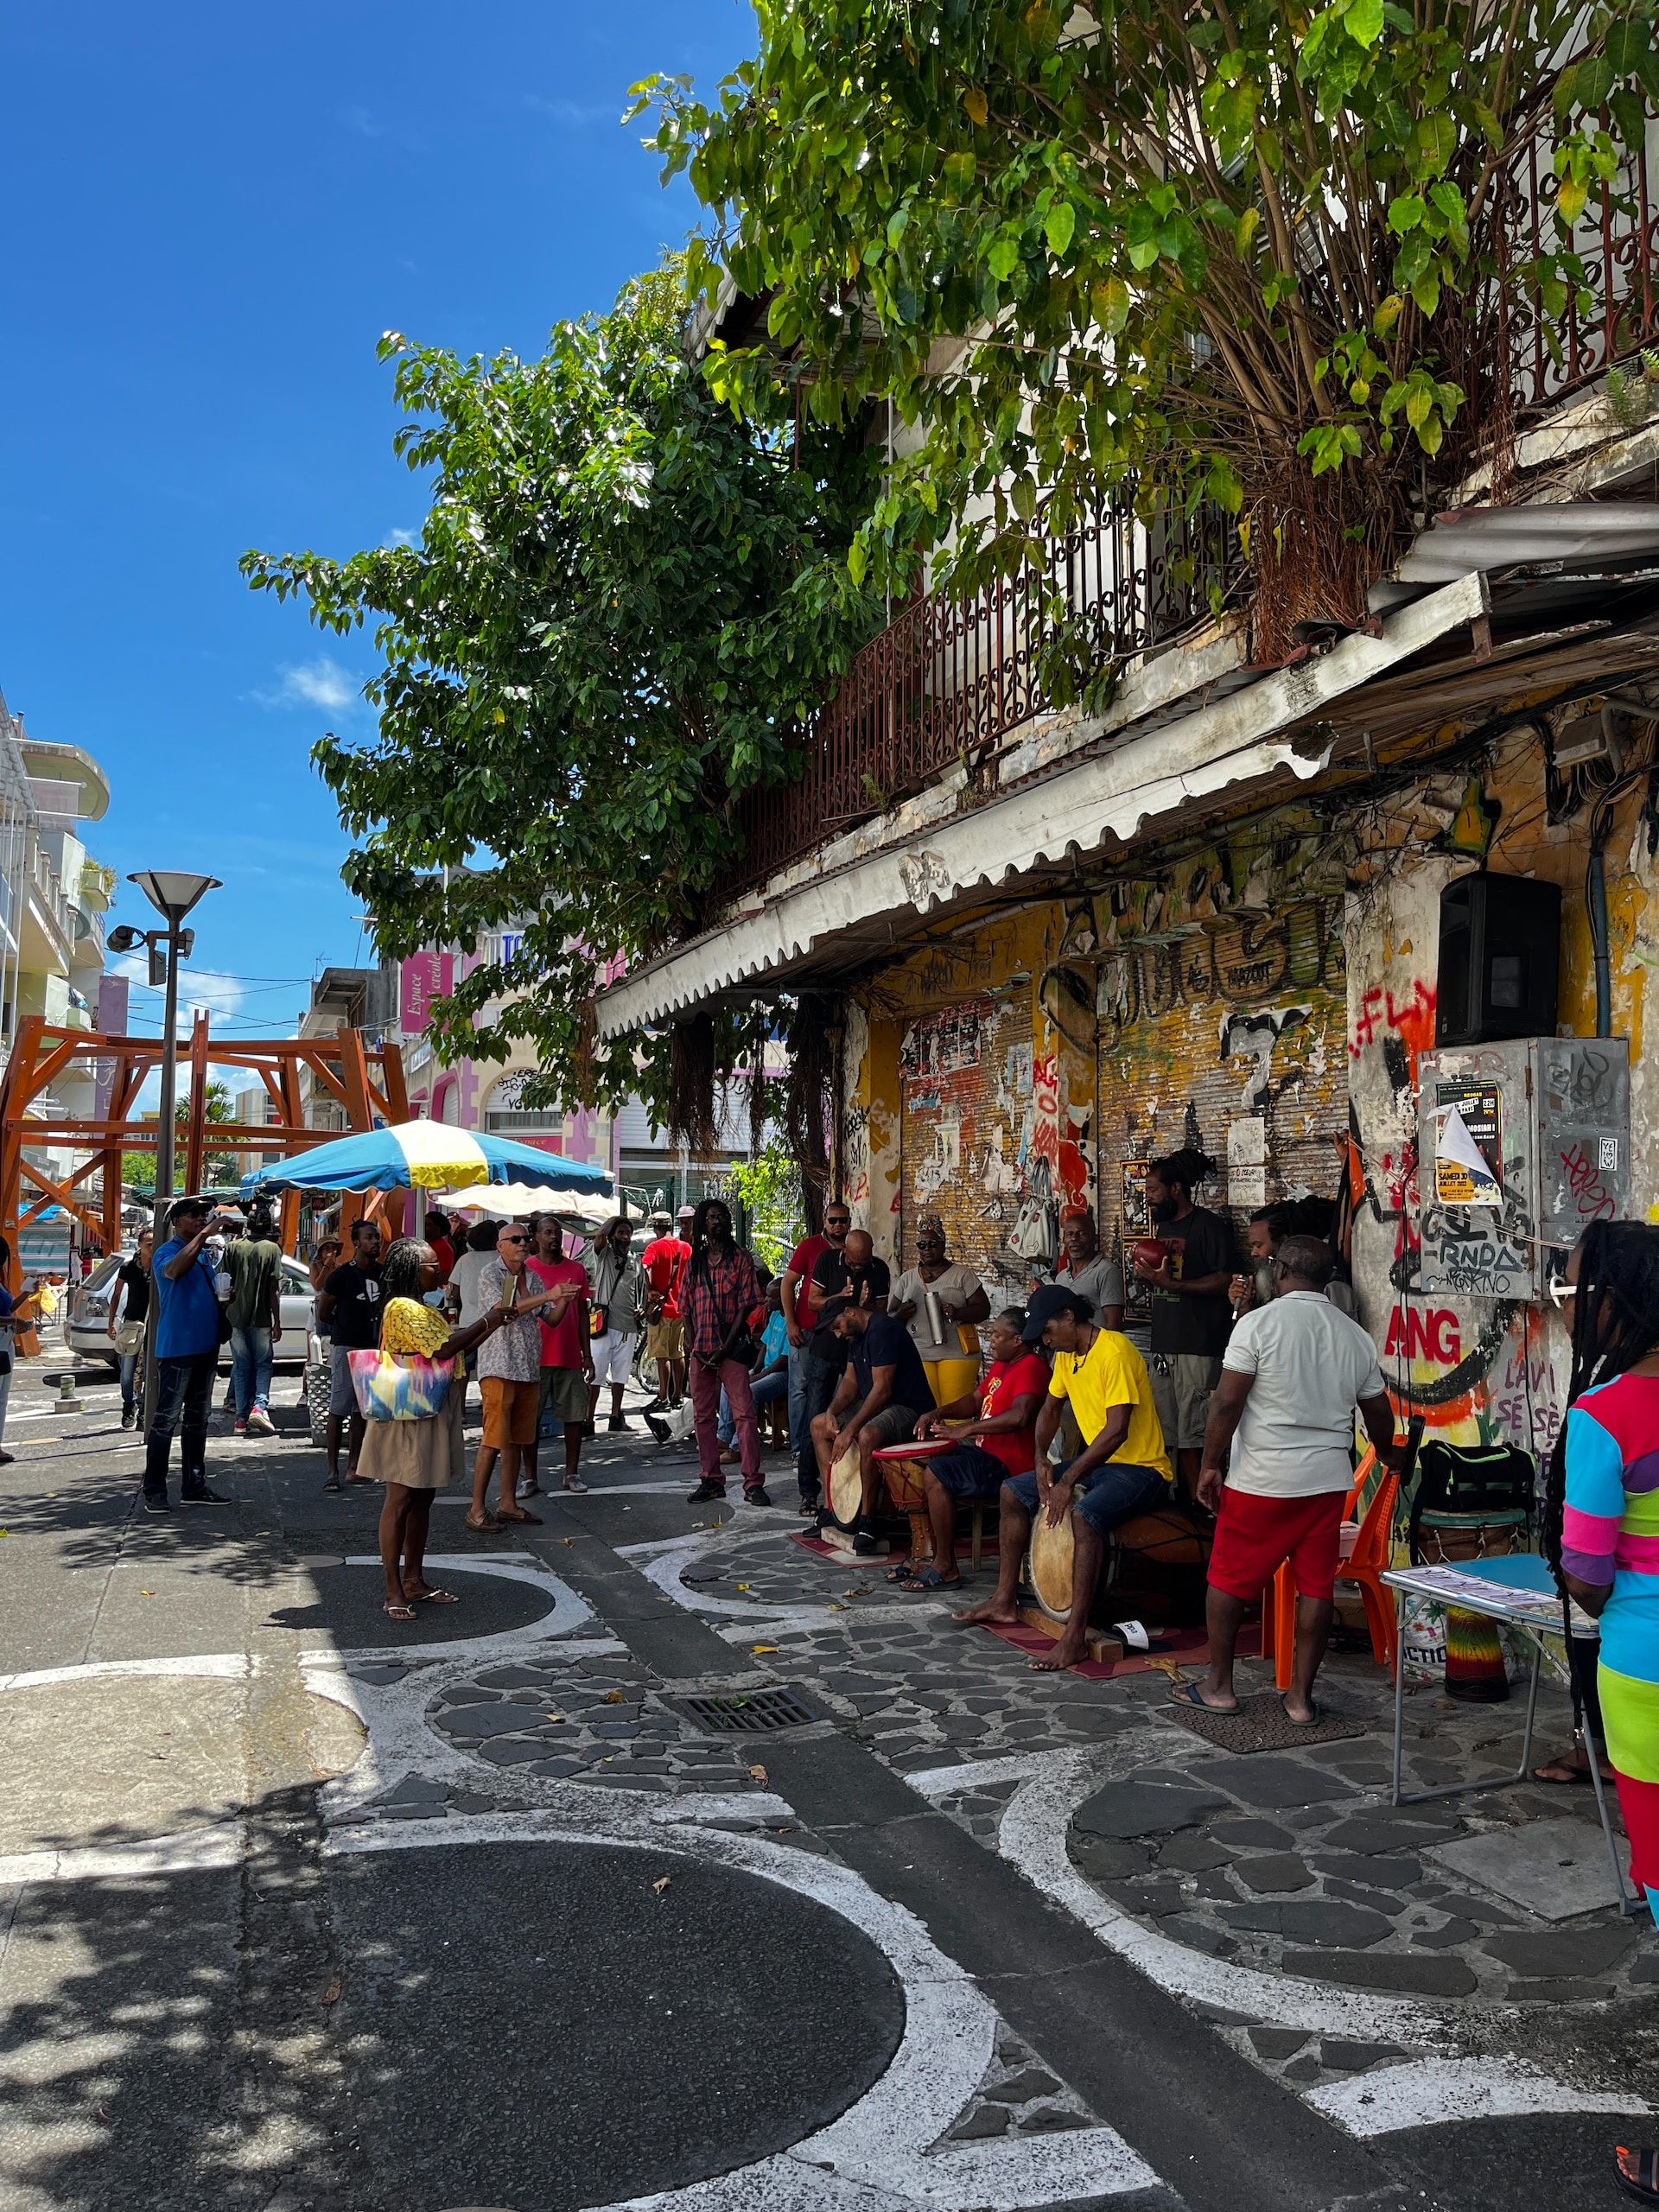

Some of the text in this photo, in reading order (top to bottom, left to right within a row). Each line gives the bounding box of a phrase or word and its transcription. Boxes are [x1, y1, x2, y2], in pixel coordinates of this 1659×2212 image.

[427, 953, 442, 989] créole
[407, 973, 425, 1016] Espace
[1384, 1305, 1461, 1365] ANG
